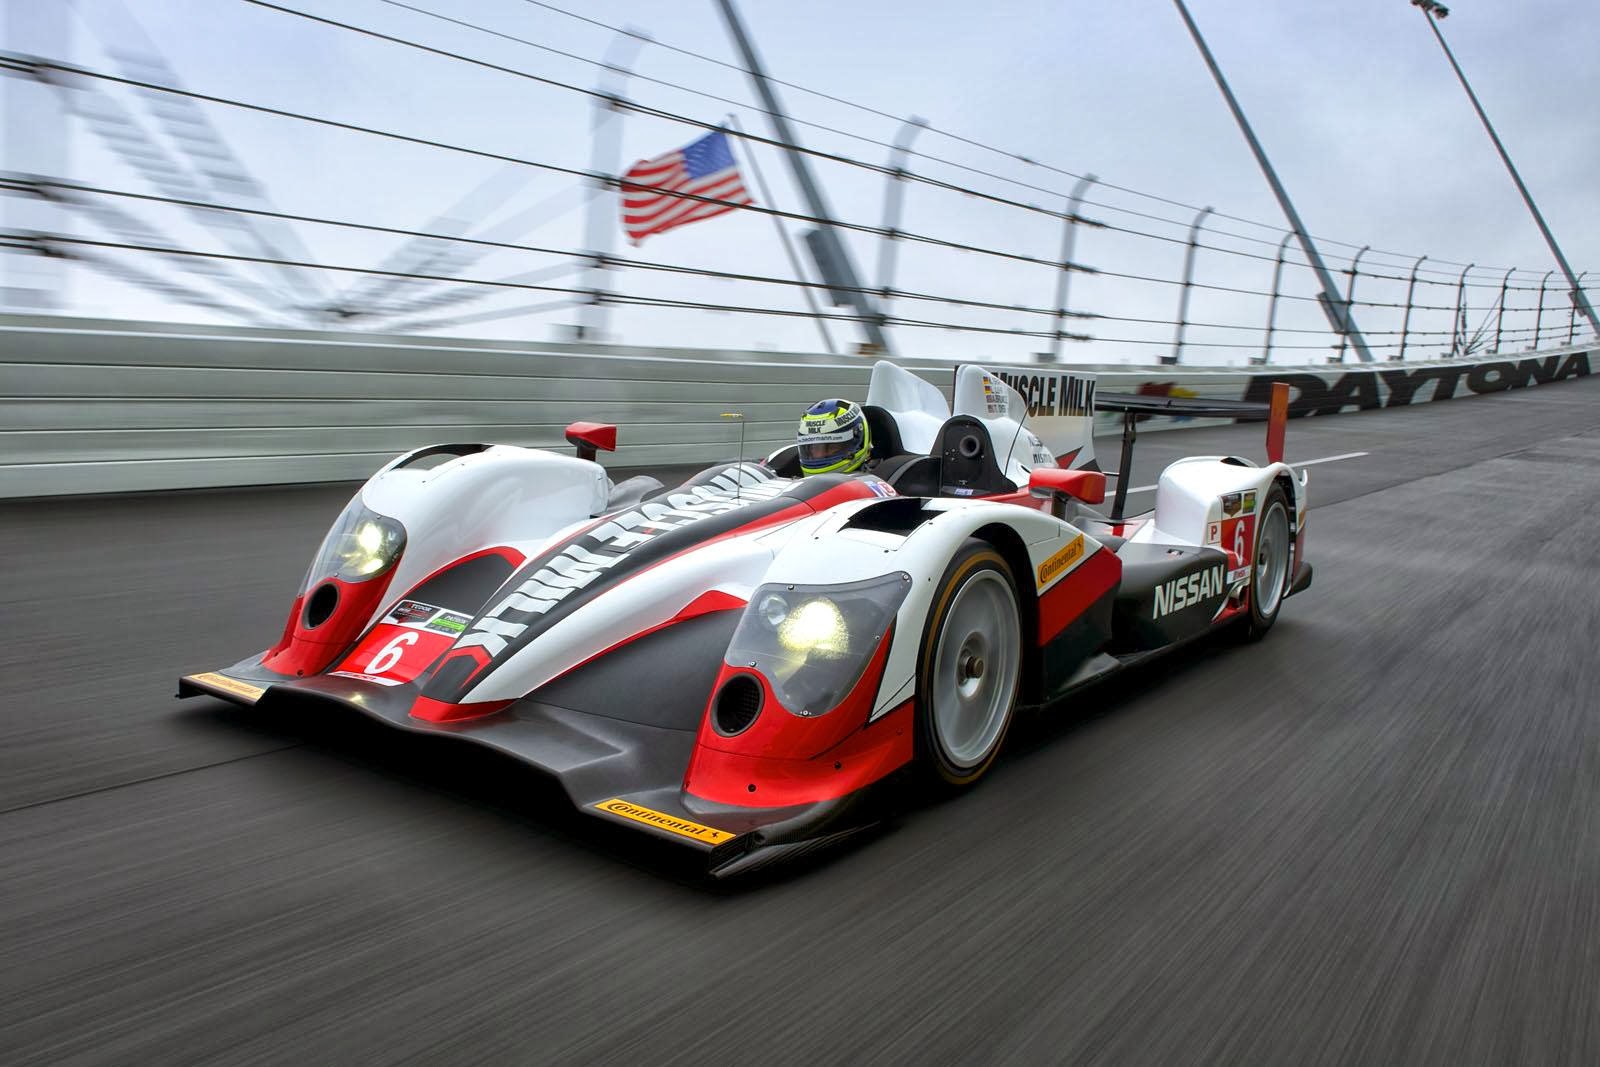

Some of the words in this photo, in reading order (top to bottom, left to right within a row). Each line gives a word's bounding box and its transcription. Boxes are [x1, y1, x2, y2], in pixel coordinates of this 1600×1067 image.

[991, 372, 1057, 418] SCLE
[1058, 375, 1096, 417] MILK
[1233, 352, 1590, 424] DAYTONA
[806, 420, 826, 428] MUSCLE
[1210, 525, 1218, 541] P
[1234, 519, 1246, 566] 6
[451, 545, 630, 657] MILK
[1153, 564, 1225, 620] NISSAN
[364, 631, 420, 675] 6
[607, 802, 706, 836] Continental
